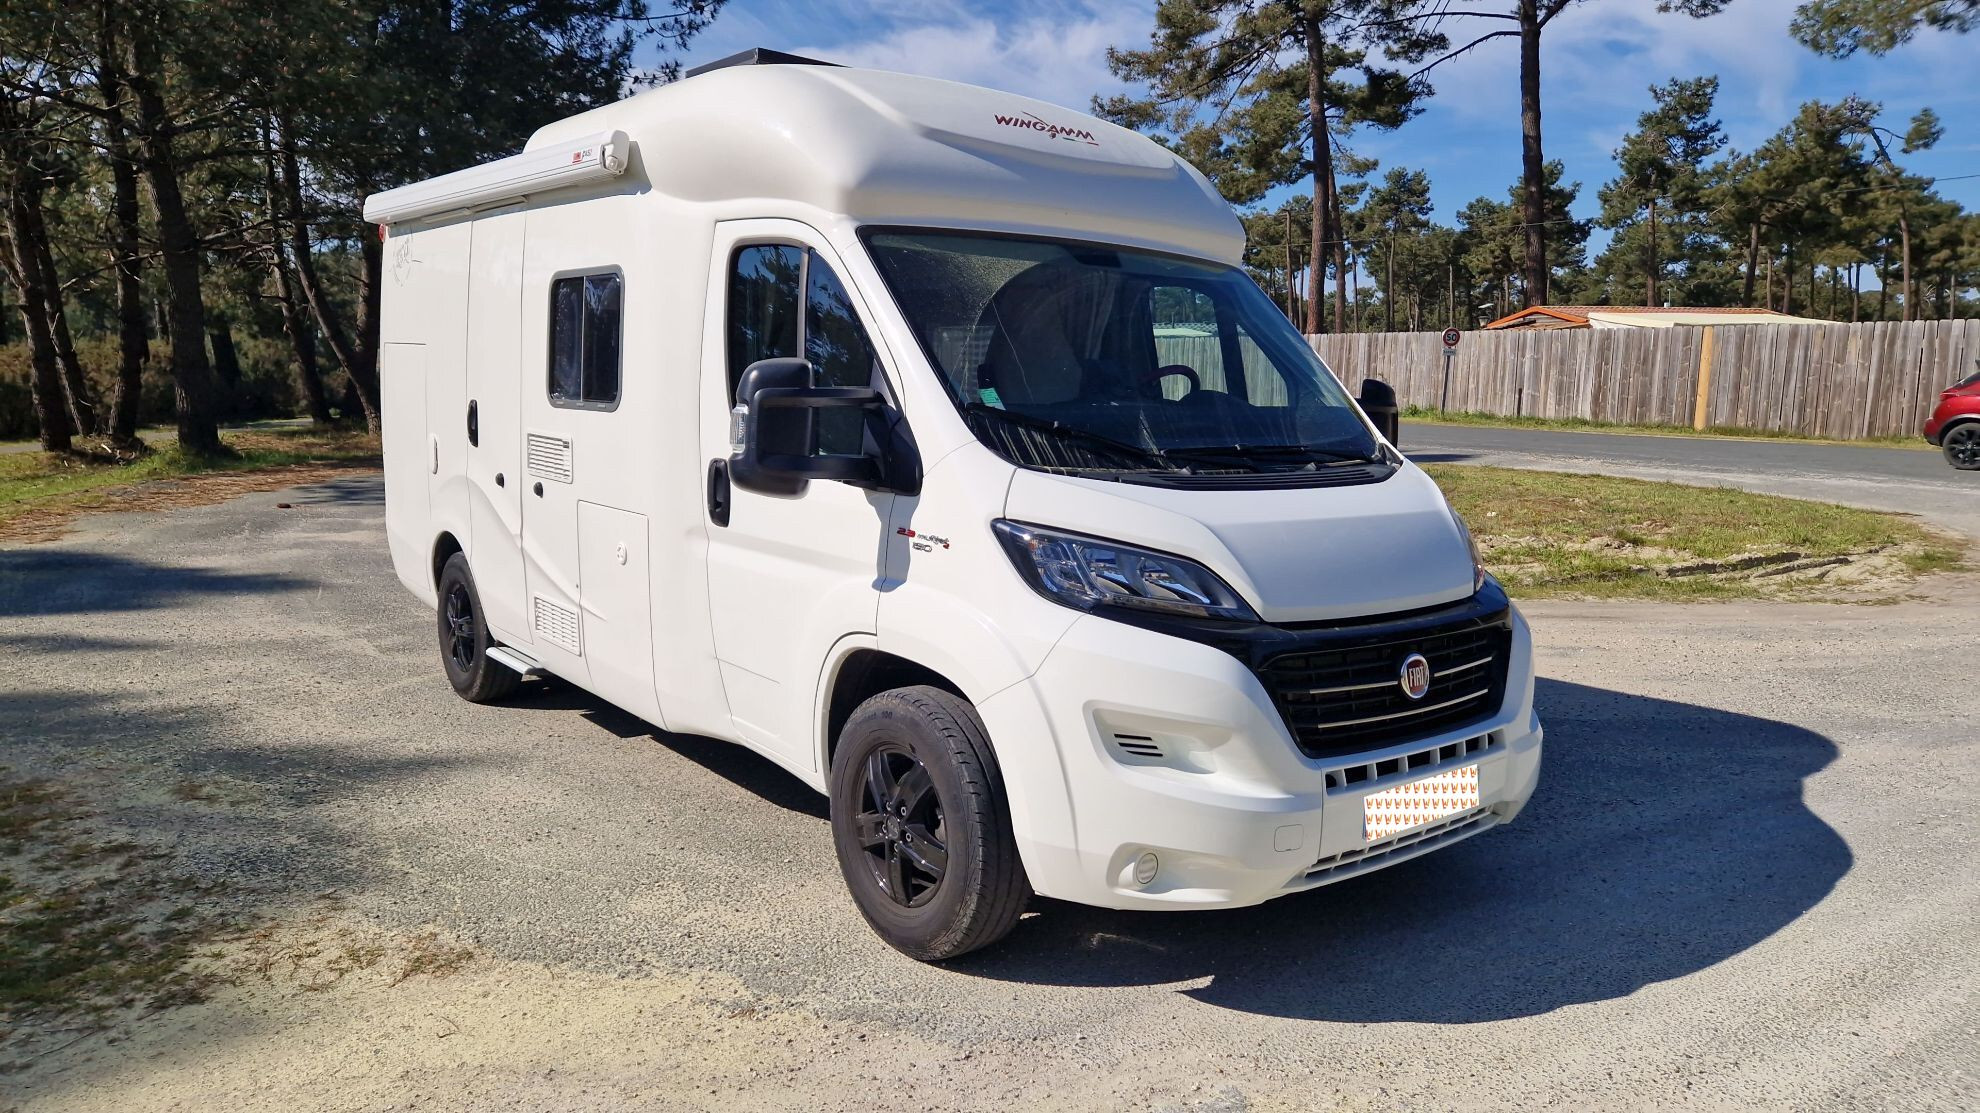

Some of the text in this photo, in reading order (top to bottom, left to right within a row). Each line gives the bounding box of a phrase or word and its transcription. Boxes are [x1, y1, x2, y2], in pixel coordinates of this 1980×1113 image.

[994, 114, 1095, 141] WINGAMM
[1446, 333, 1457, 341] 50
[1409, 666, 1424, 687] FIAT
